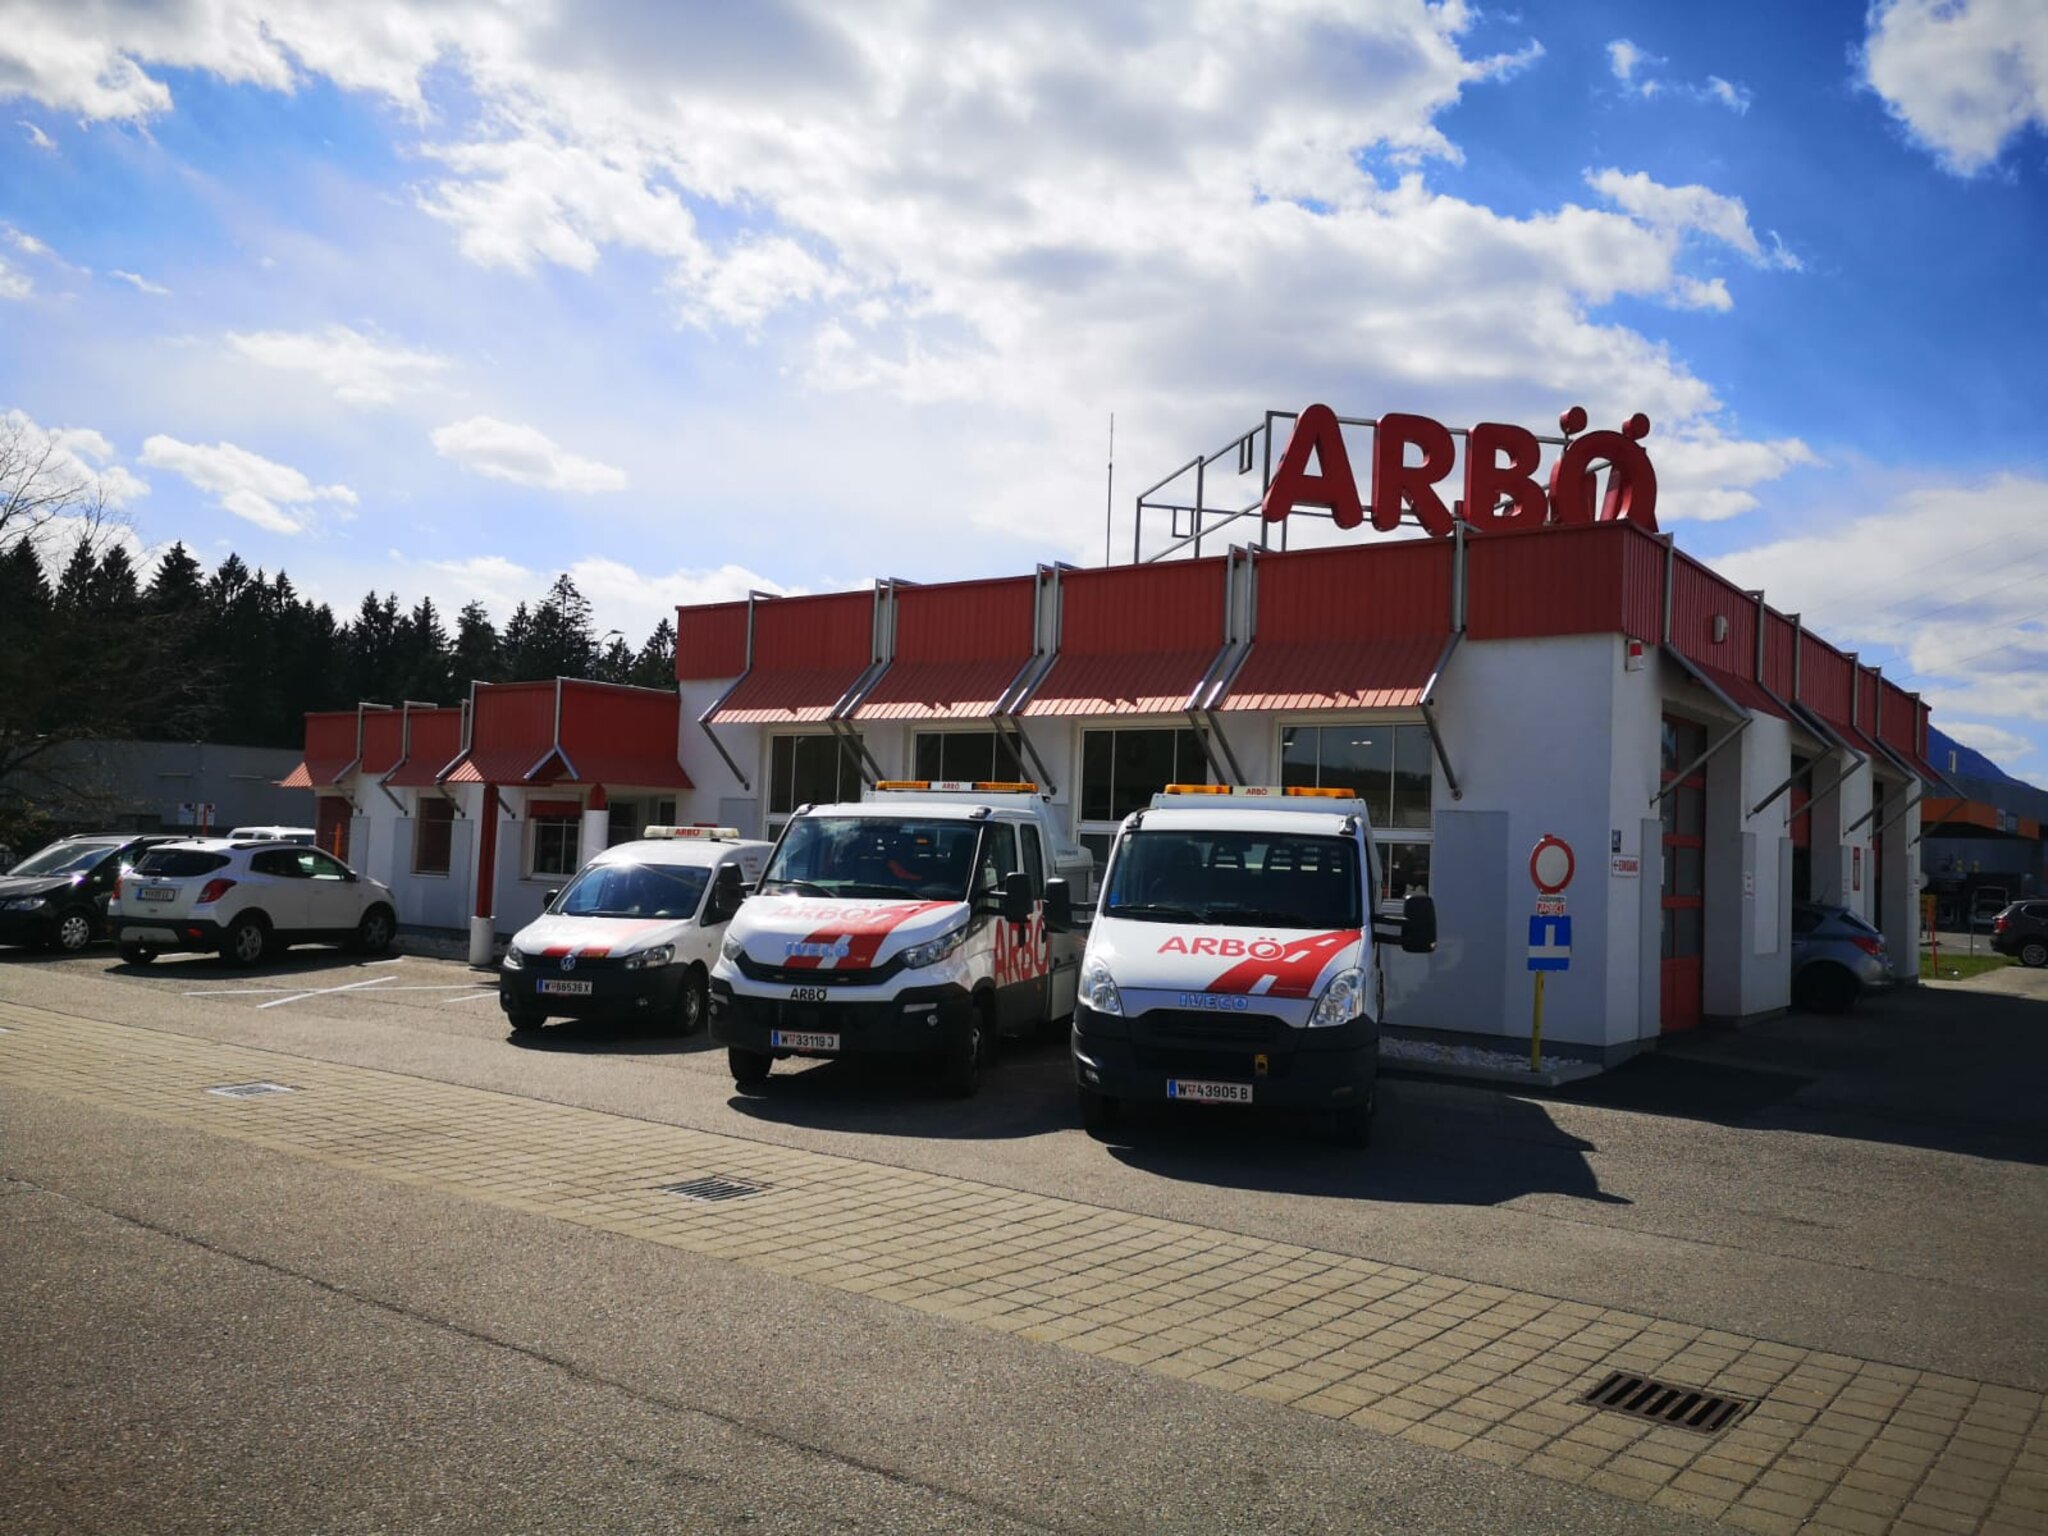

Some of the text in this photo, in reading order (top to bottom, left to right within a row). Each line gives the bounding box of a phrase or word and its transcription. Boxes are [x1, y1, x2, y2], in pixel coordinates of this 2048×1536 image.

[1262, 403, 1659, 537] ARBÖ
[784, 941, 850, 957] IVECO
[1157, 936, 1283, 960] ARBÖ
[790, 987, 828, 1001] ARBÖ
[1179, 992, 1249, 1011] IVECO
